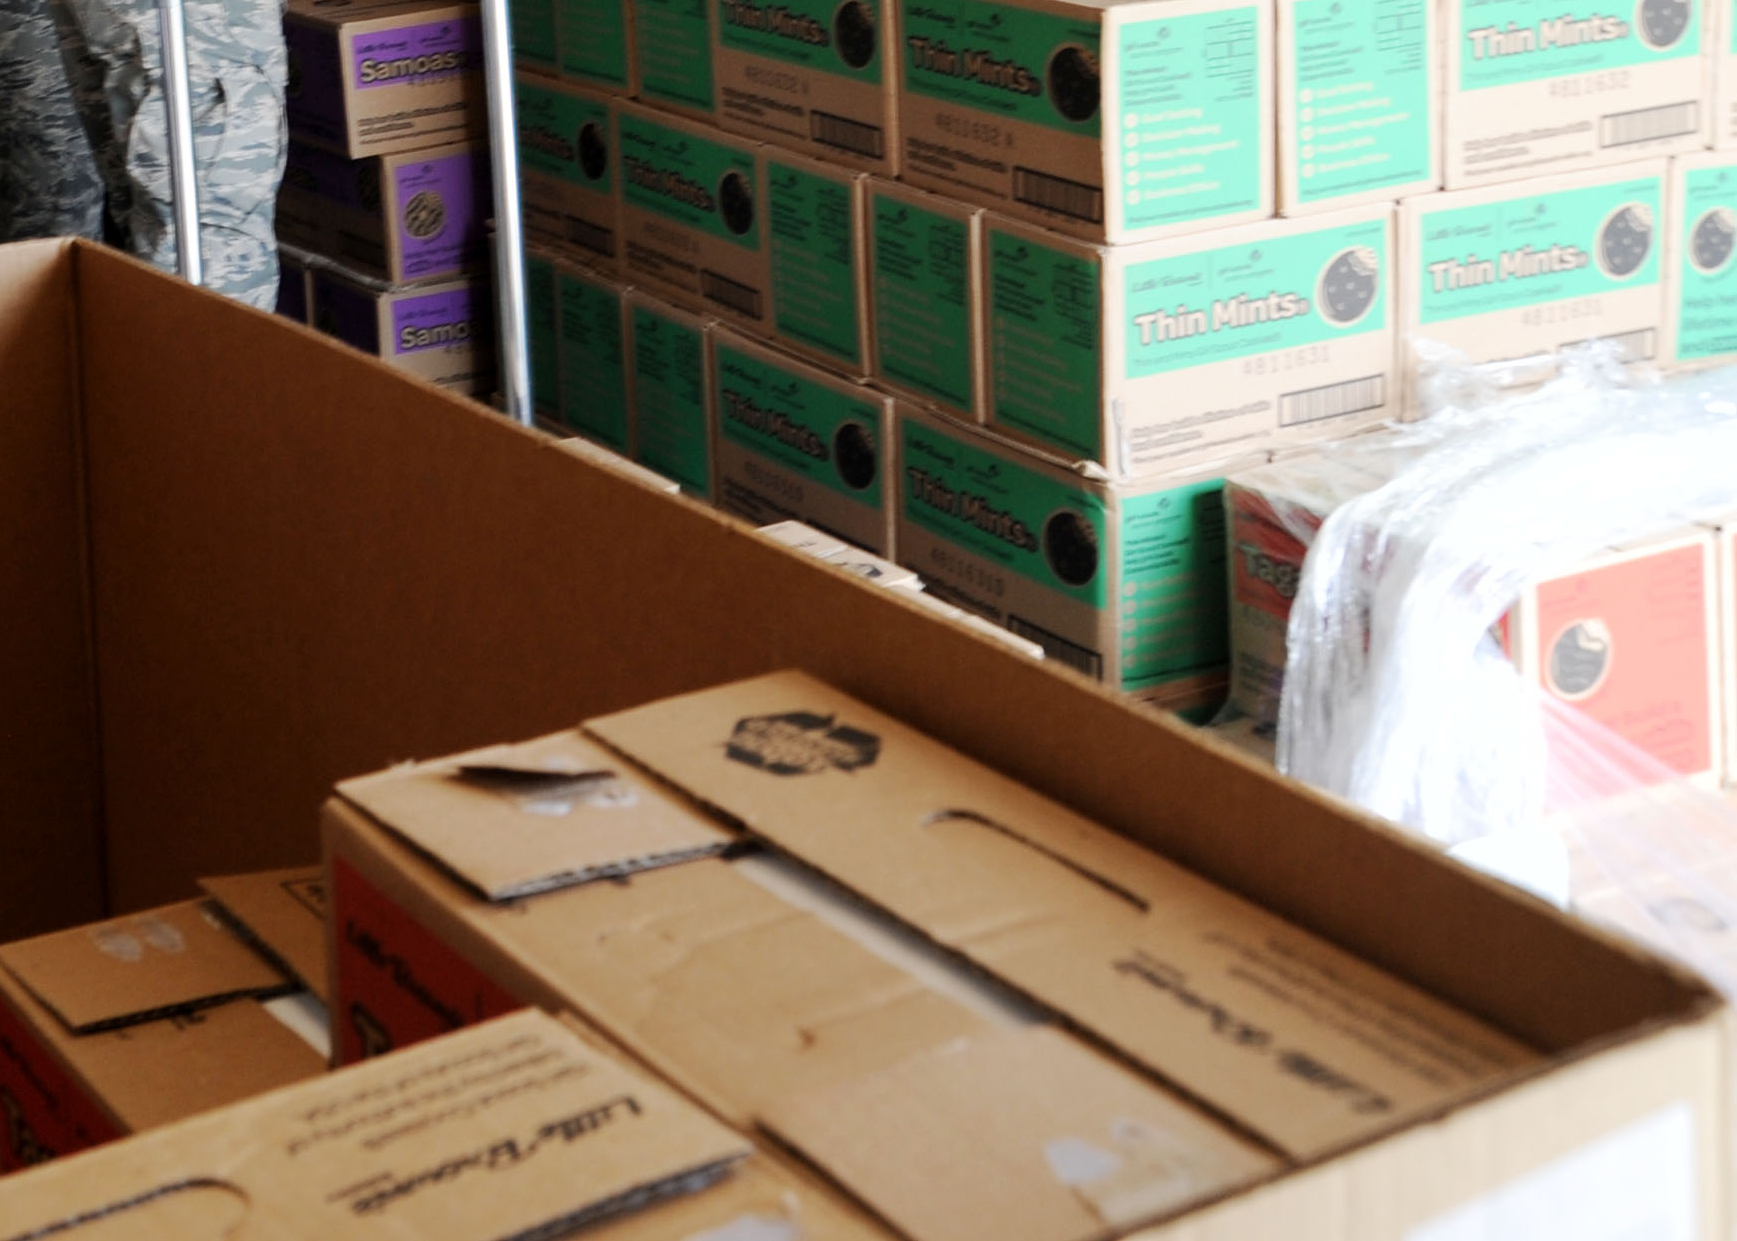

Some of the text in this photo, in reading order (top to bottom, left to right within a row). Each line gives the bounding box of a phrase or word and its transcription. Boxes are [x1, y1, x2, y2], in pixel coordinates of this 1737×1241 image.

[908, 35, 960, 78] Thin
[1466, 21, 1536, 61] Thin
[1538, 12, 1620, 51] Mints
[359, 49, 461, 85] Samoas
[1427, 243, 1581, 294] Thin Mints
[1132, 290, 1299, 347] Thin Mints
[907, 465, 960, 514] Thin
